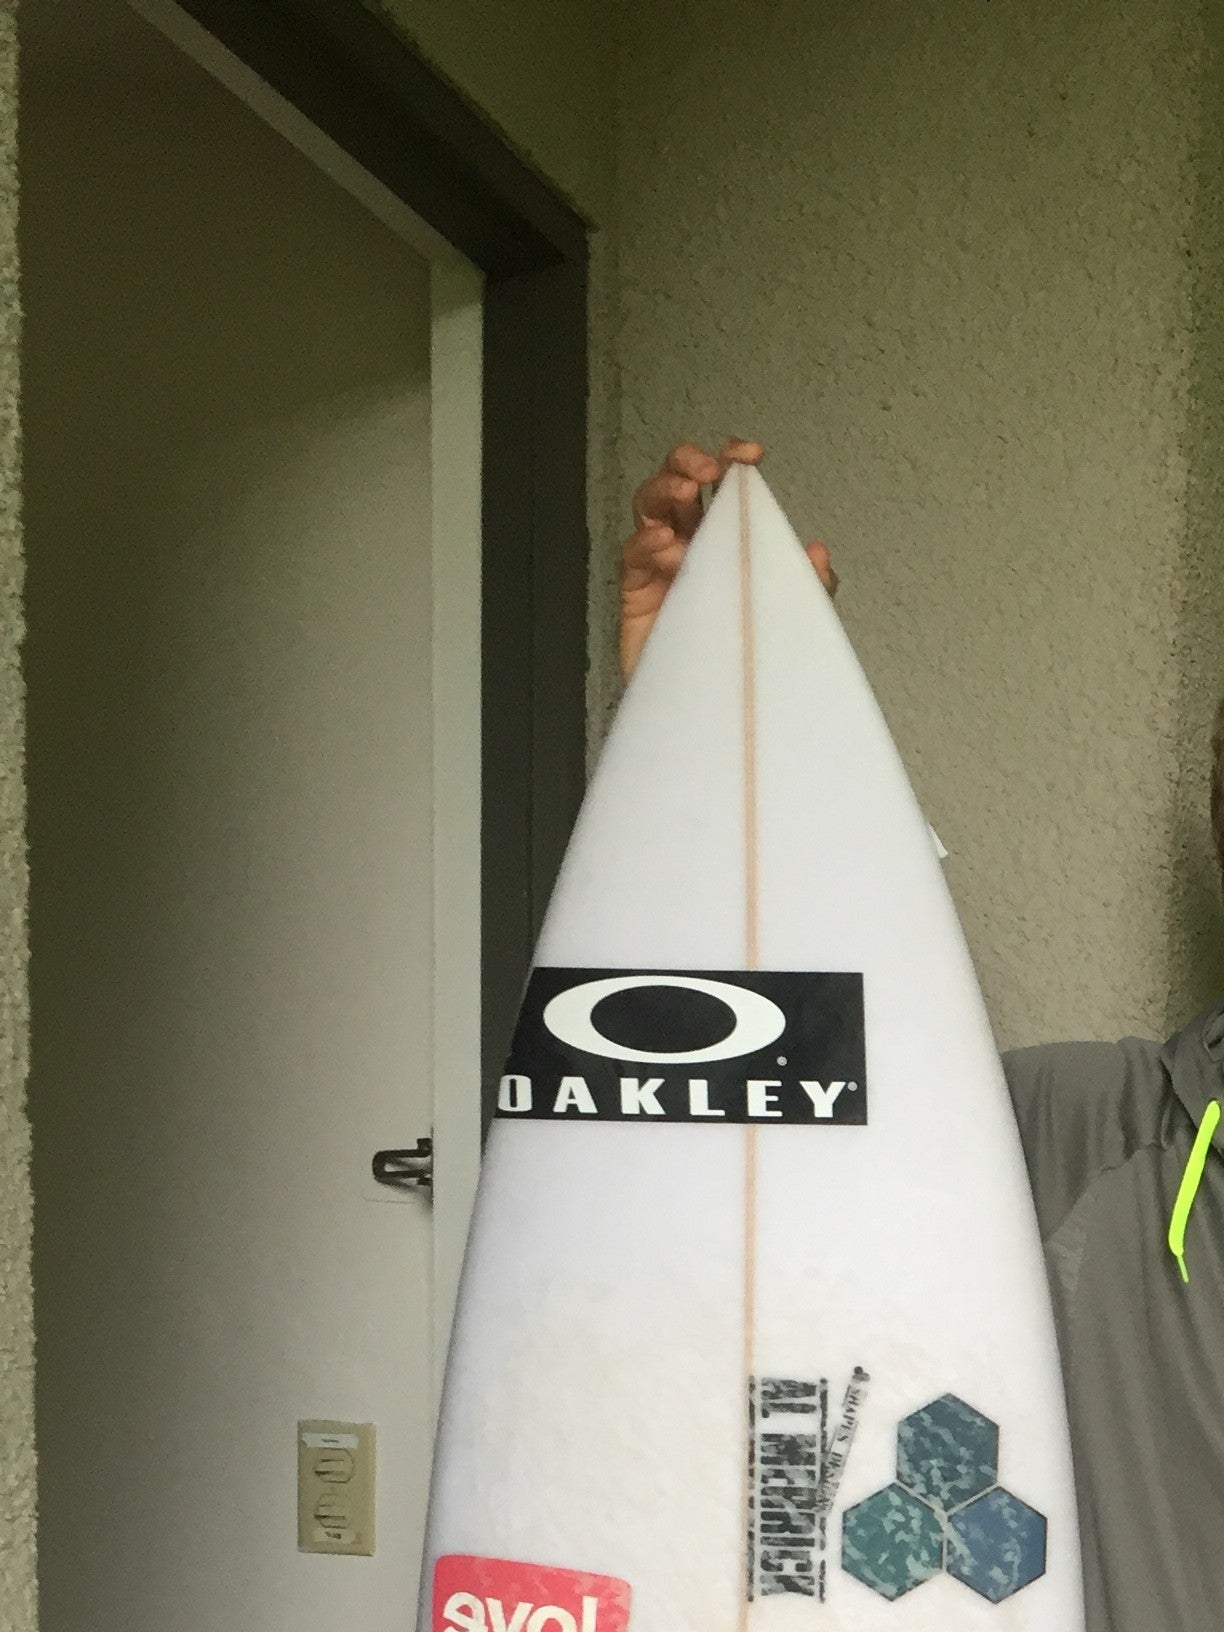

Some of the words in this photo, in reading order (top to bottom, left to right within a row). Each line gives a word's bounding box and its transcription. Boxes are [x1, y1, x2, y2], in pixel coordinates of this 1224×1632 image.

[498, 1074, 845, 1118] OAKLEY
[760, 1377, 818, 1418] AL
[760, 1433, 818, 1597] MERRICK
